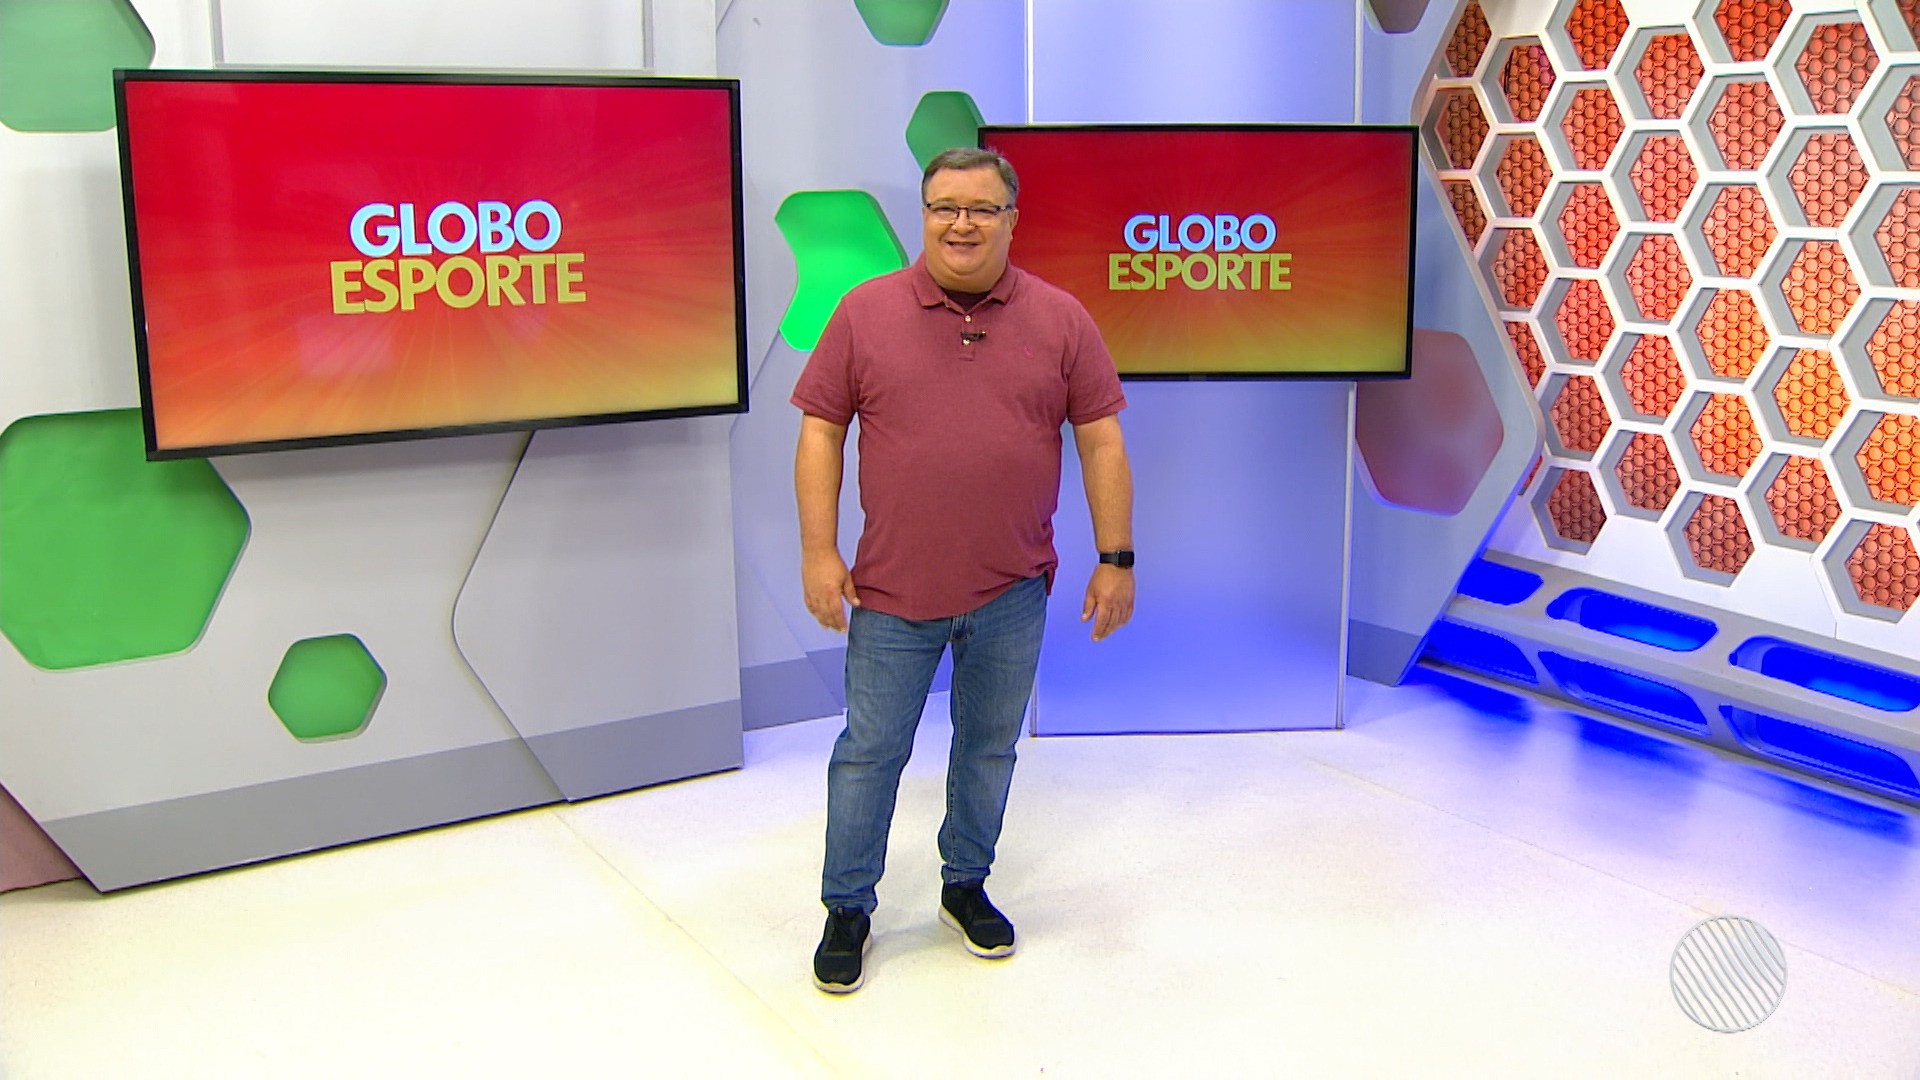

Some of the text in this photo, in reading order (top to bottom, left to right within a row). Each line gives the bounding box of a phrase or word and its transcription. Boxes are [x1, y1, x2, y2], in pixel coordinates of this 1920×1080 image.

[350, 200, 562, 257] GLOBO
[1123, 213, 1277, 252] GLOBO
[330, 253, 586, 314] ESPORTE
[1108, 253, 1292, 290] ESPORTE
